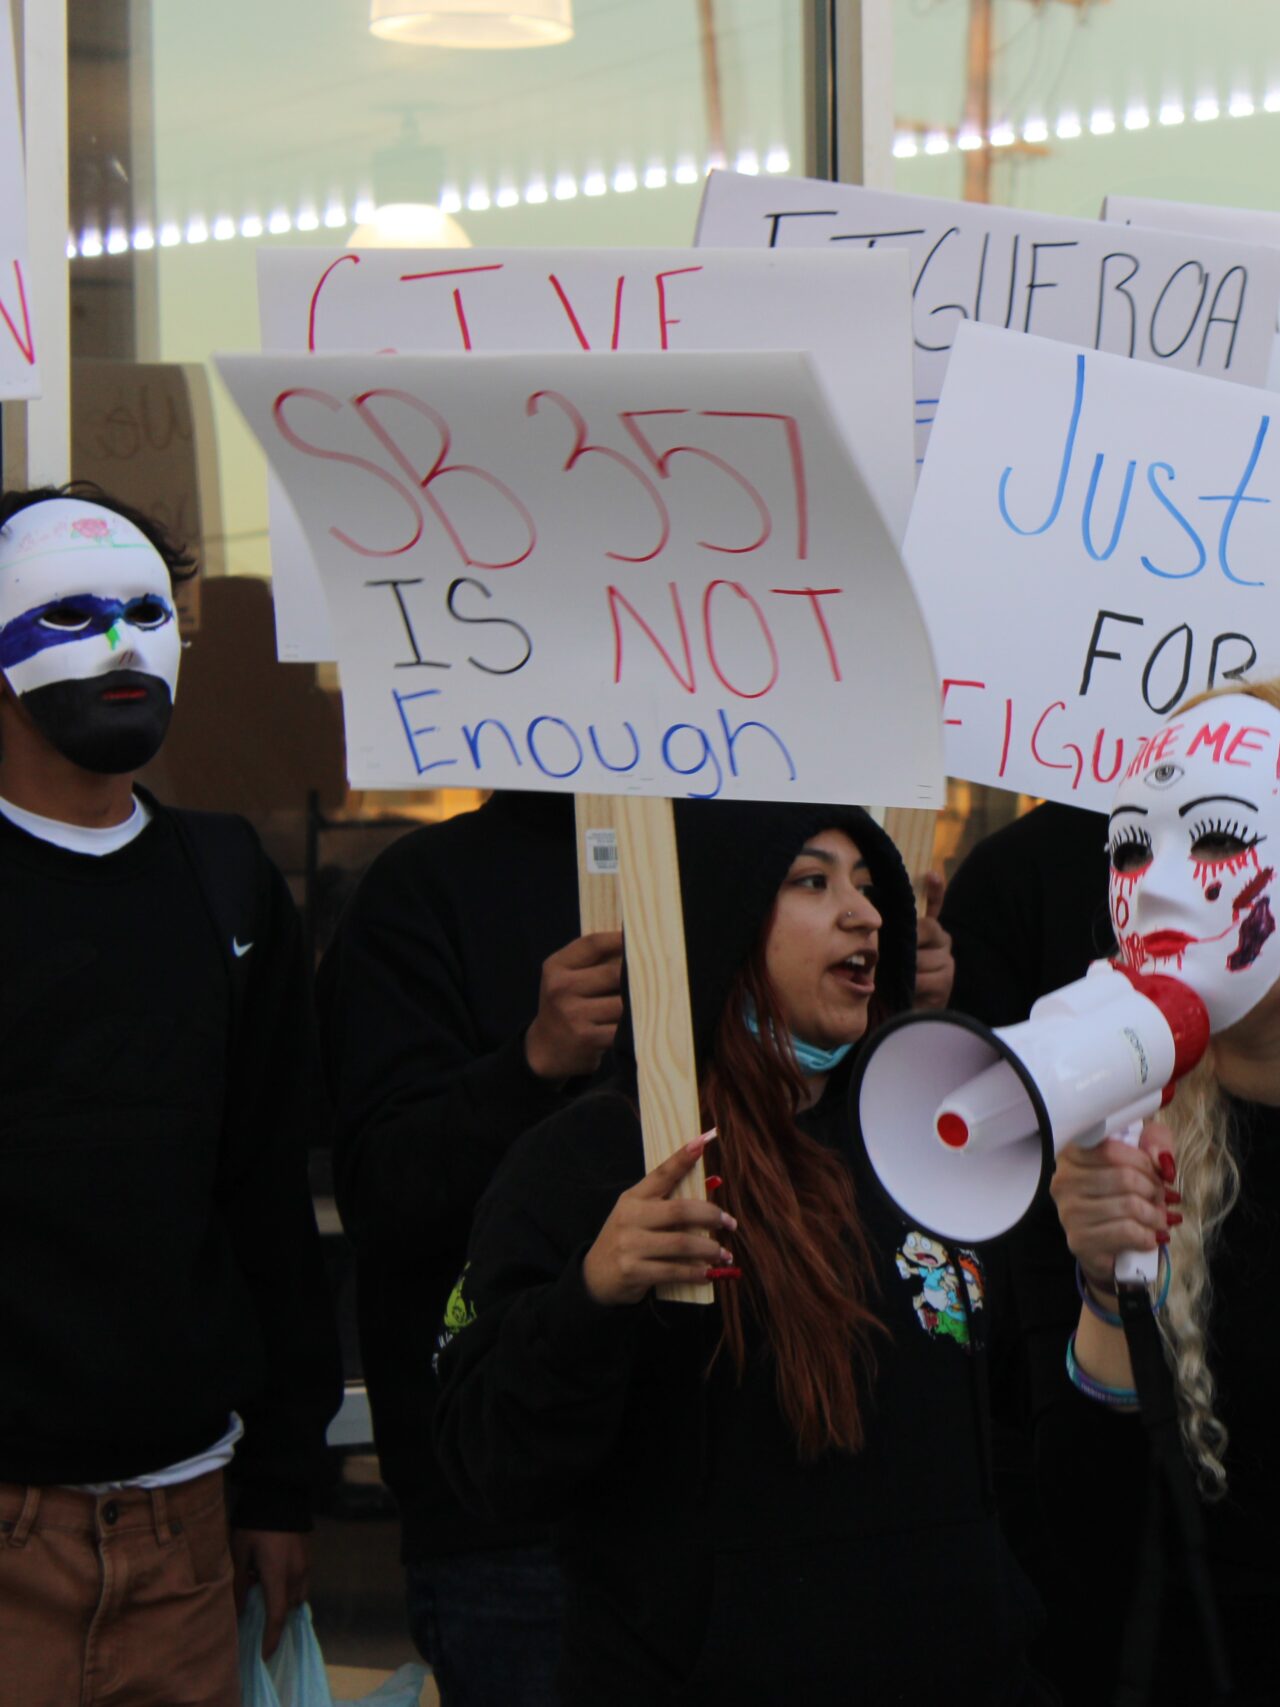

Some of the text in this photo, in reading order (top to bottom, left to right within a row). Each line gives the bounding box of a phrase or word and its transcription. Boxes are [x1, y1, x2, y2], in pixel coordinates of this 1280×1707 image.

[273, 388, 537, 570] SB
[526, 389, 808, 564] 357
[364, 577, 843, 699] IS NOT
[1078, 609, 1258, 715] FOR
[391, 688, 796, 799] Enough
